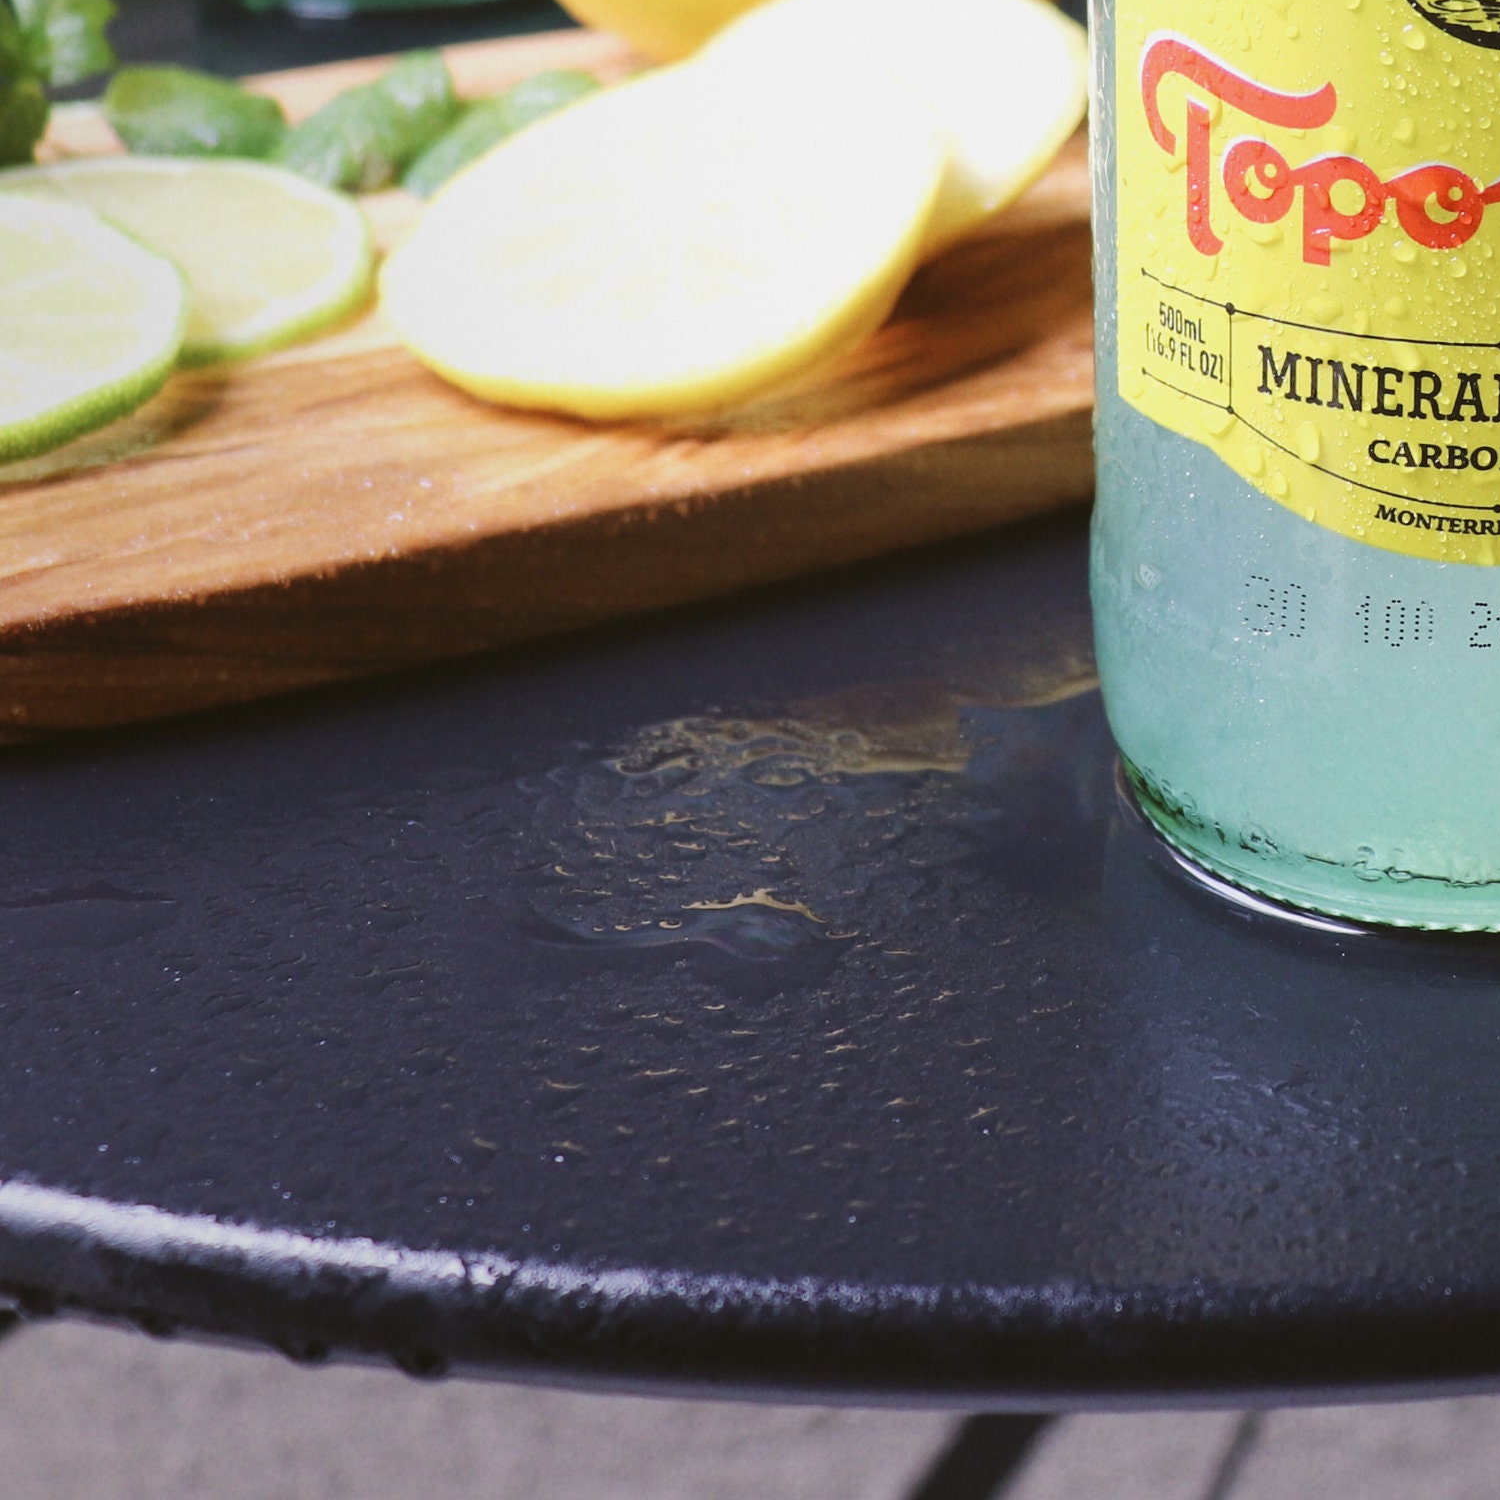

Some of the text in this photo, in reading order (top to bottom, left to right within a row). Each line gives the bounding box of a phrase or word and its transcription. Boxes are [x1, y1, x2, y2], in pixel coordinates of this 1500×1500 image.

[1140, 29, 1484, 267] Topo
[1159, 301, 1206, 345] 500mL
[1180, 342, 1196, 372] FL
